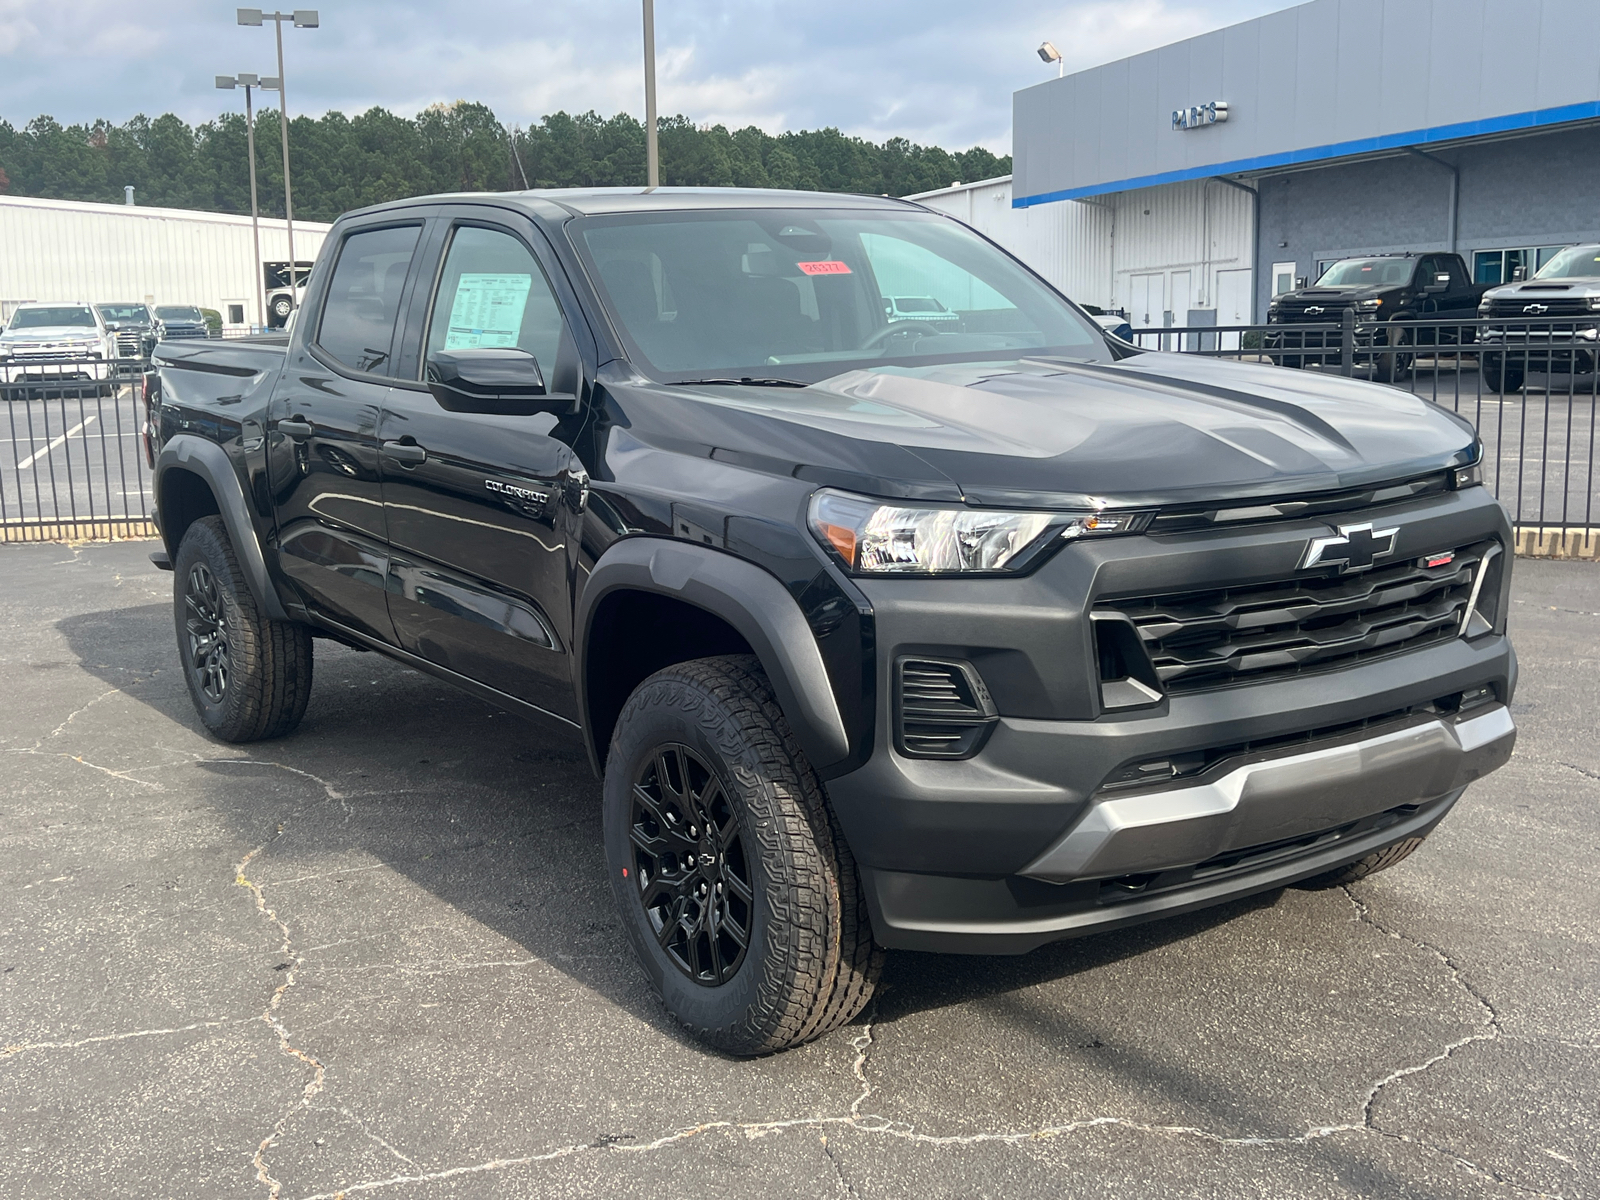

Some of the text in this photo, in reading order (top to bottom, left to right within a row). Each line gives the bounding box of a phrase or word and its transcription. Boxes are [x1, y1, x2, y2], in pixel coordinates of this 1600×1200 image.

[1171, 101, 1218, 131] PARTS
[804, 263, 840, 273] 26377
[485, 479, 550, 503] COLORADO
